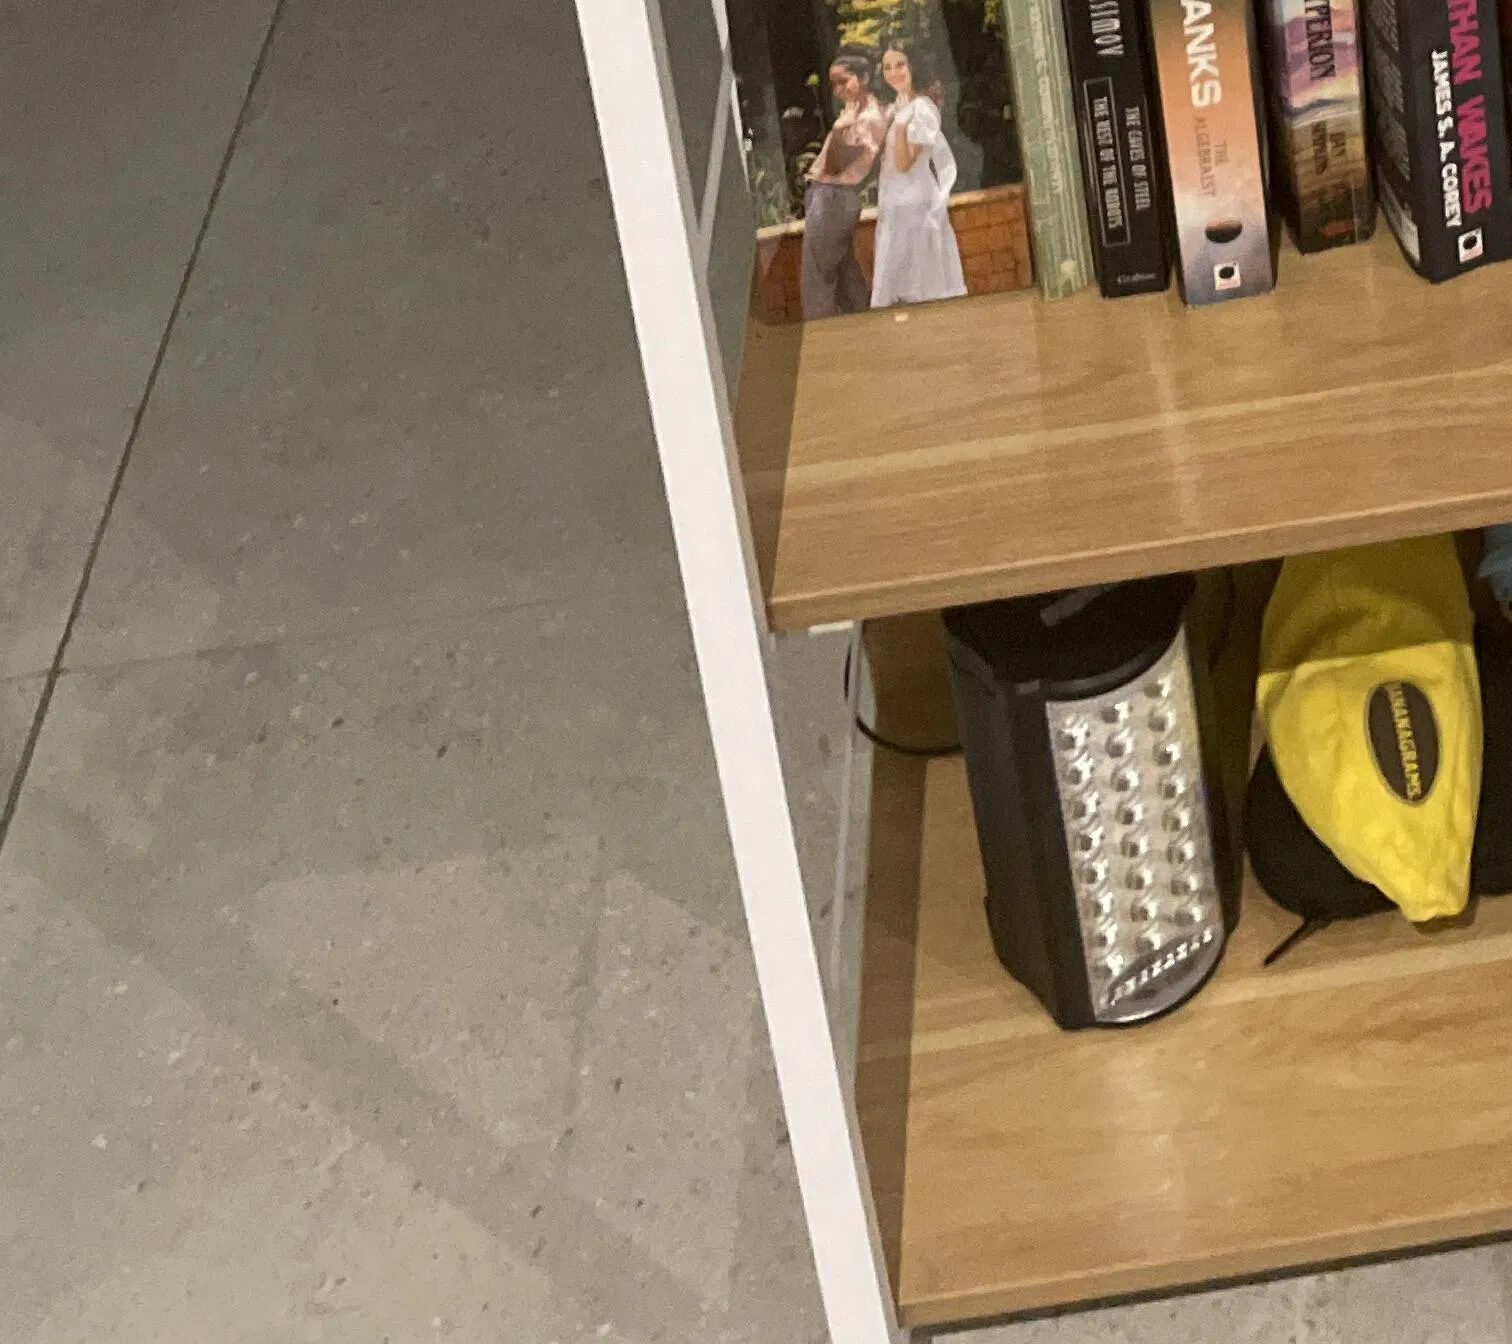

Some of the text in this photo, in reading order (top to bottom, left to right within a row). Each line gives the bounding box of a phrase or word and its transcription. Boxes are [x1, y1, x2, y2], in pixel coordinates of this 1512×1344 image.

[1193, 115, 1216, 198] ALGEBRAIST
[1431, 49, 1461, 228] JAMES S. A. COREY
[1457, 94, 1492, 214] WAKES
